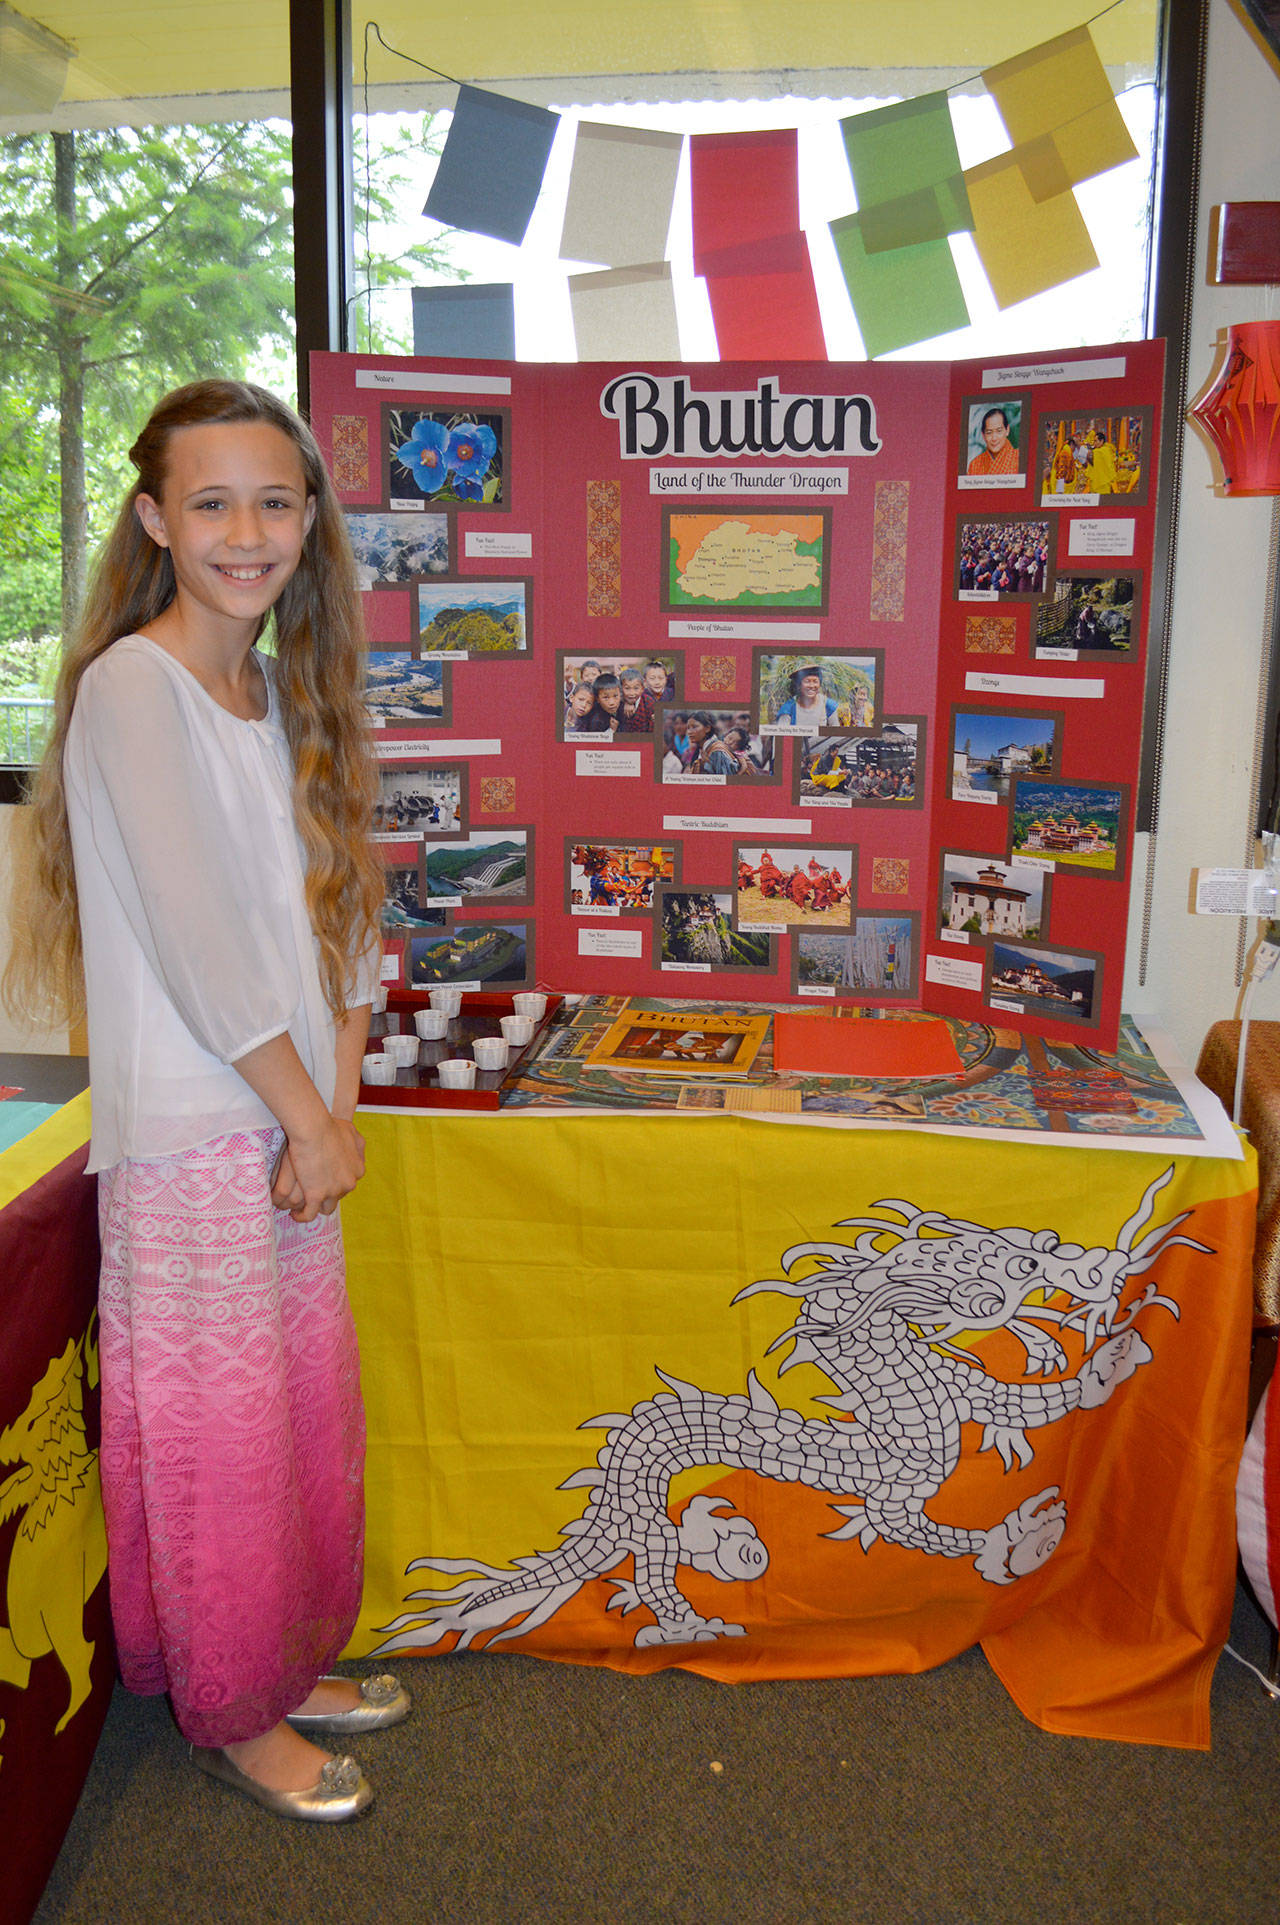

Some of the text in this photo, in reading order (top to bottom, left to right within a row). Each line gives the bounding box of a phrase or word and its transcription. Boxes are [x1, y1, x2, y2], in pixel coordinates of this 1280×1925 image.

[604, 375, 879, 456] Bhutan
[654, 472, 842, 491] Land of the Thunder Dragon
[687, 623, 705, 632] People
[637, 1012, 753, 1027] BHUTAN
